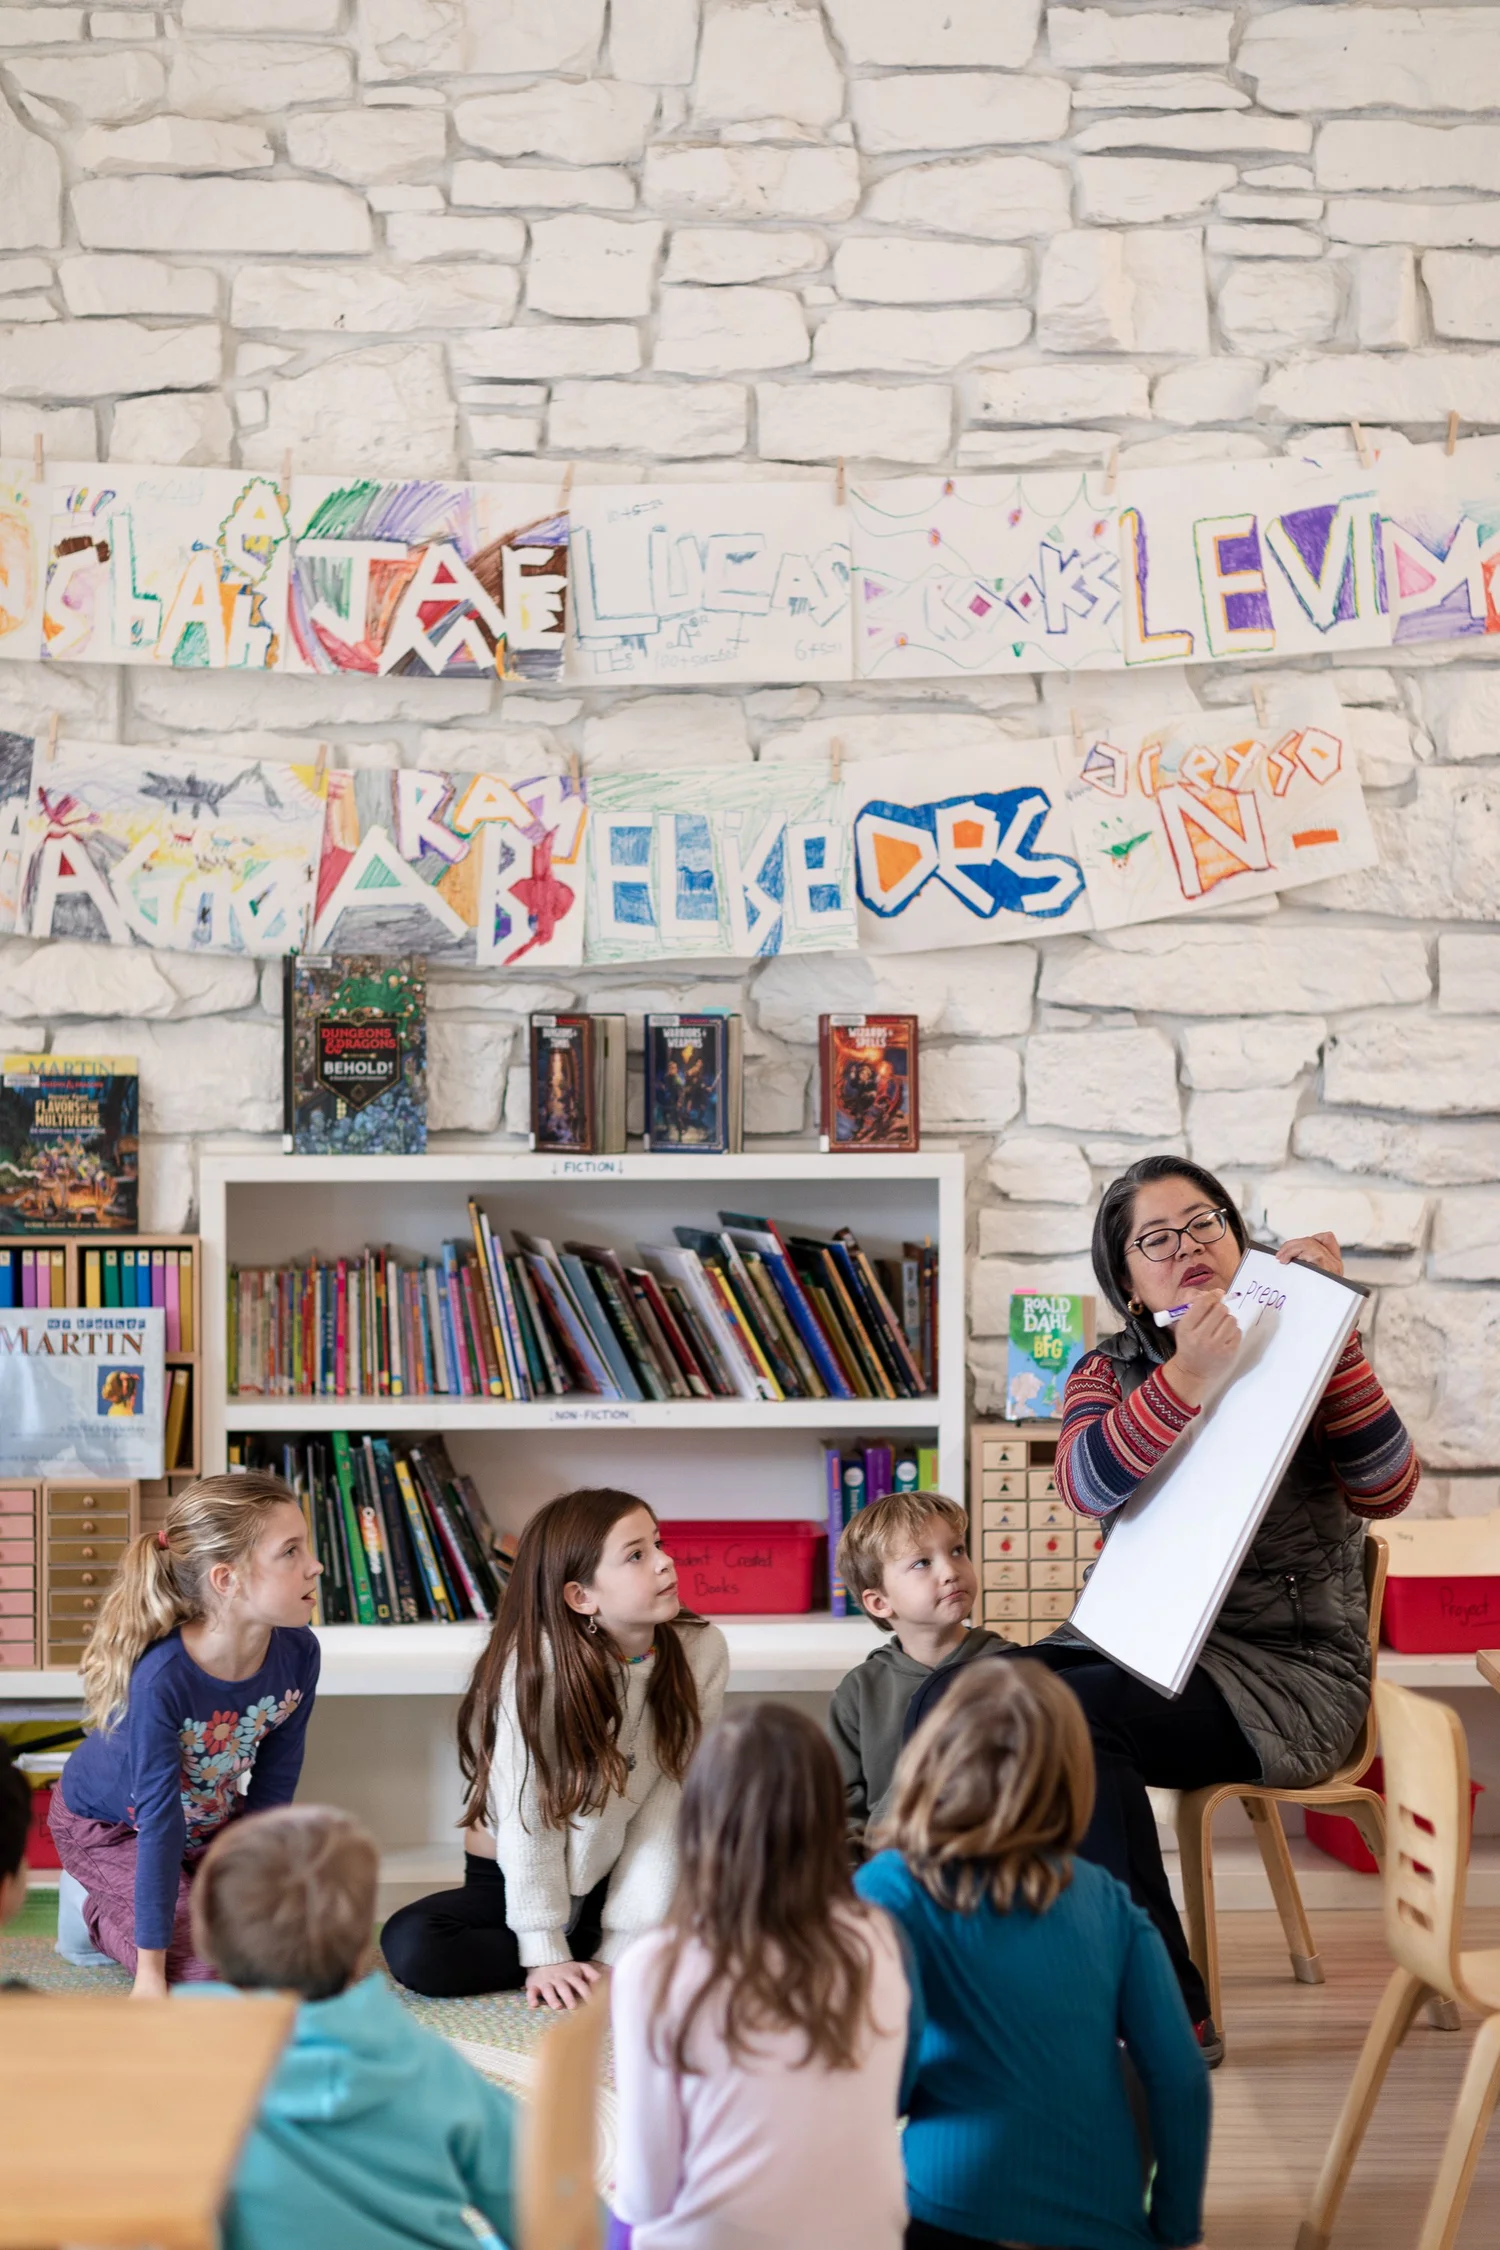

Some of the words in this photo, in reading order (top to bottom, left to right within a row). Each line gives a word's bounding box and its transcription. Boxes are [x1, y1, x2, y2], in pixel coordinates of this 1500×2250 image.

[321, 1028, 391, 1039] DUNGEONS
[336, 1039, 396, 1049] DRAGONS
[28, 1061, 116, 1075] MARTIN
[324, 1061, 393, 1075] BEHOLD!
[35, 1100, 80, 1113] FLAVORS
[35, 1113, 99, 1127] MULTIVERSE
[563, 1161, 615, 1173] FICTION
[1023, 1314, 1072, 1333] DAHL
[0, 1326, 143, 1356] MARTIN
[1034, 1334, 1063, 1359] BFG
[554, 1409, 629, 1421] NON-FICTION
[672, 1546, 711, 1567] tudent
[694, 1573, 740, 1597] Books
[1439, 1585, 1489, 1626] Project
